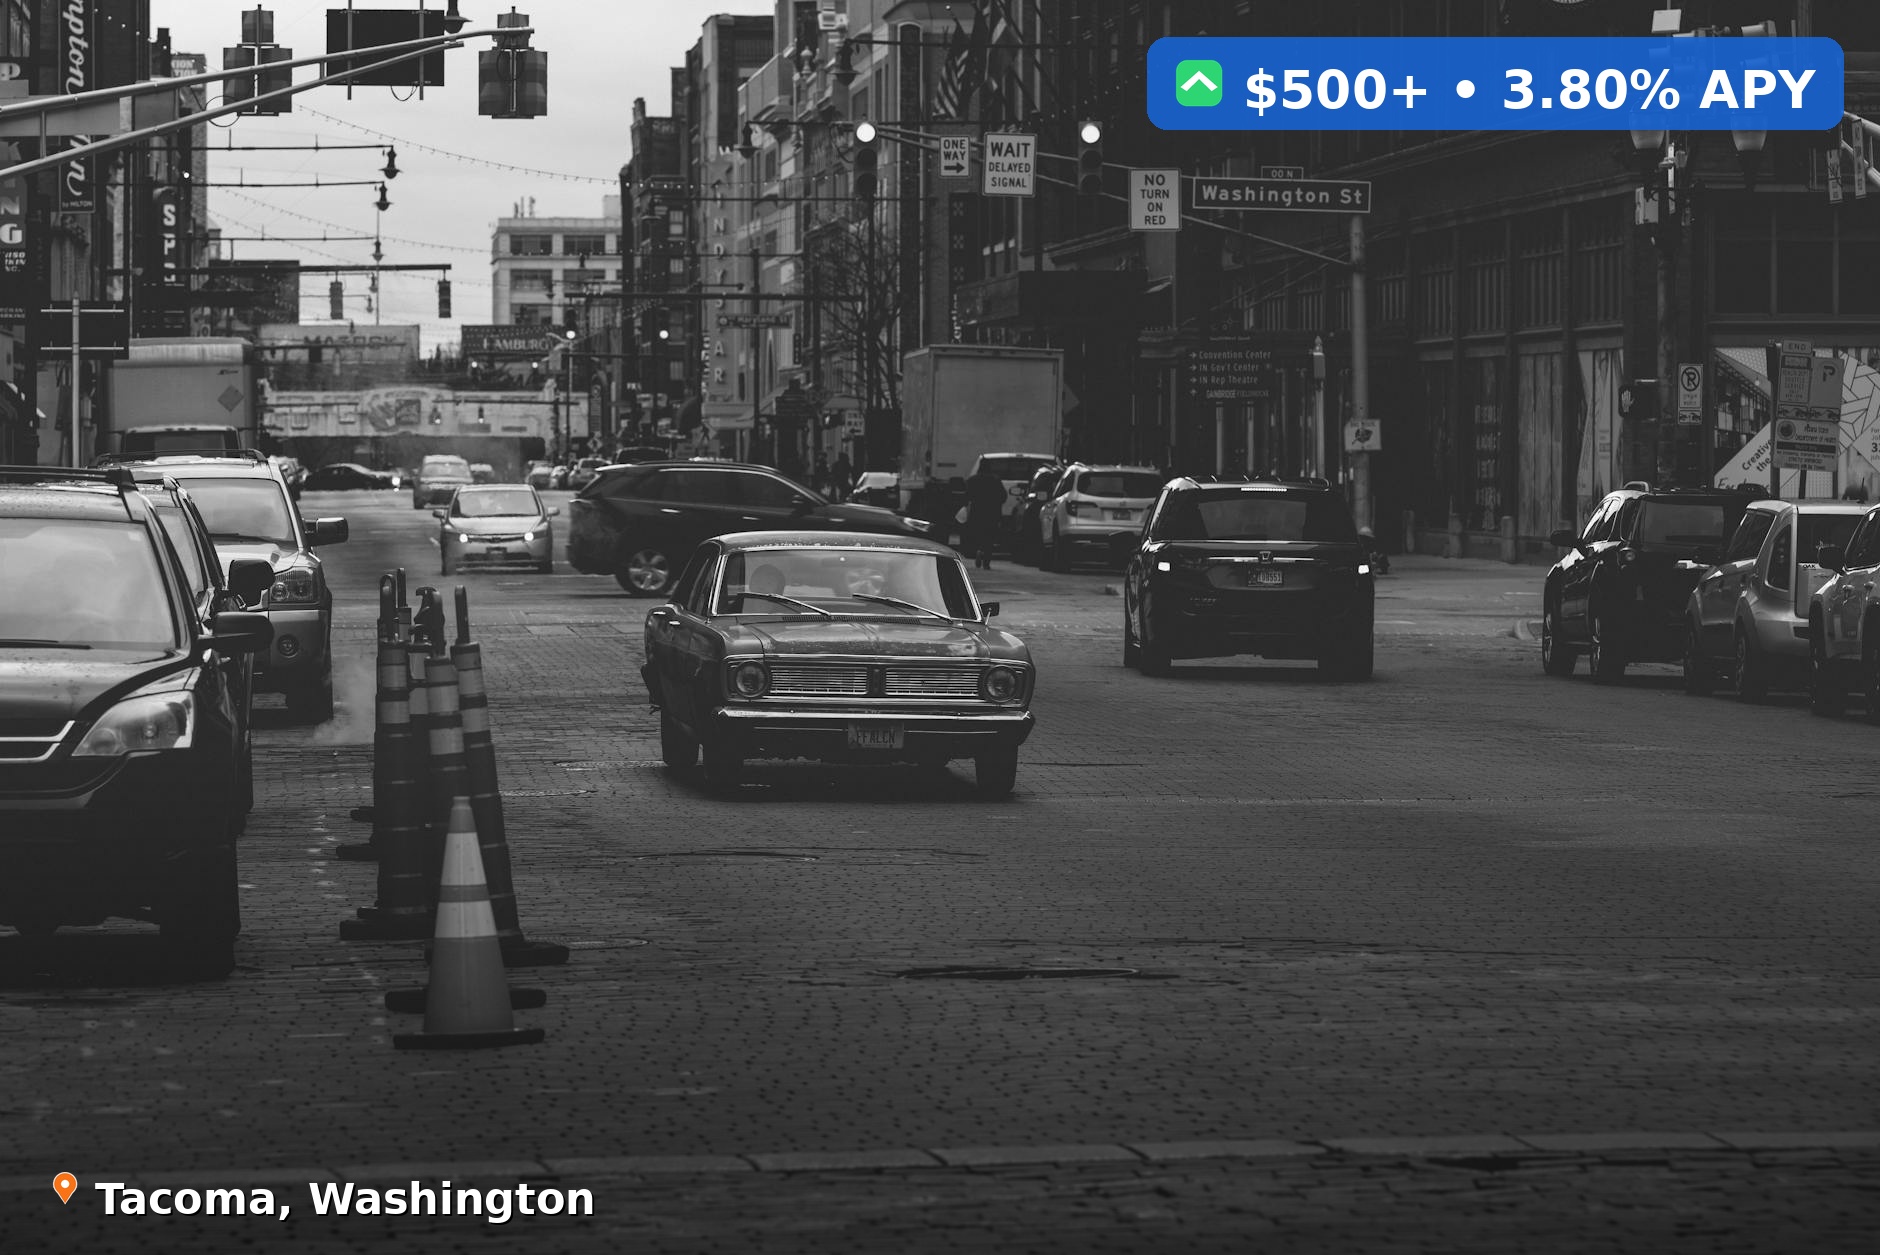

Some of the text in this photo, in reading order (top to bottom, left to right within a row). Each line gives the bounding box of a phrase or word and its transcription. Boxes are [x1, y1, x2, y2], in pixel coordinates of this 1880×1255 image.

[943, 139, 966, 149] ONE
[991, 142, 1031, 158] WAIT
[943, 151, 966, 161] WAY
[988, 161, 1031, 173] DELAYED
[991, 176, 1027, 188] SIGNAL
[1144, 174, 1166, 186] NO
[1141, 188, 1170, 200] TURN
[1202, 185, 1362, 207] Washington St
[71, 200, 93, 211] HILTON
[1147, 202, 1163, 213] ON
[1144, 215, 1166, 226] RED
[1199, 350, 1271, 360] Convention Center
[1199, 363, 1208, 372] IN
[1233, 363, 1259, 372] Center
[1199, 376, 1259, 386] IN Rep Theatre
